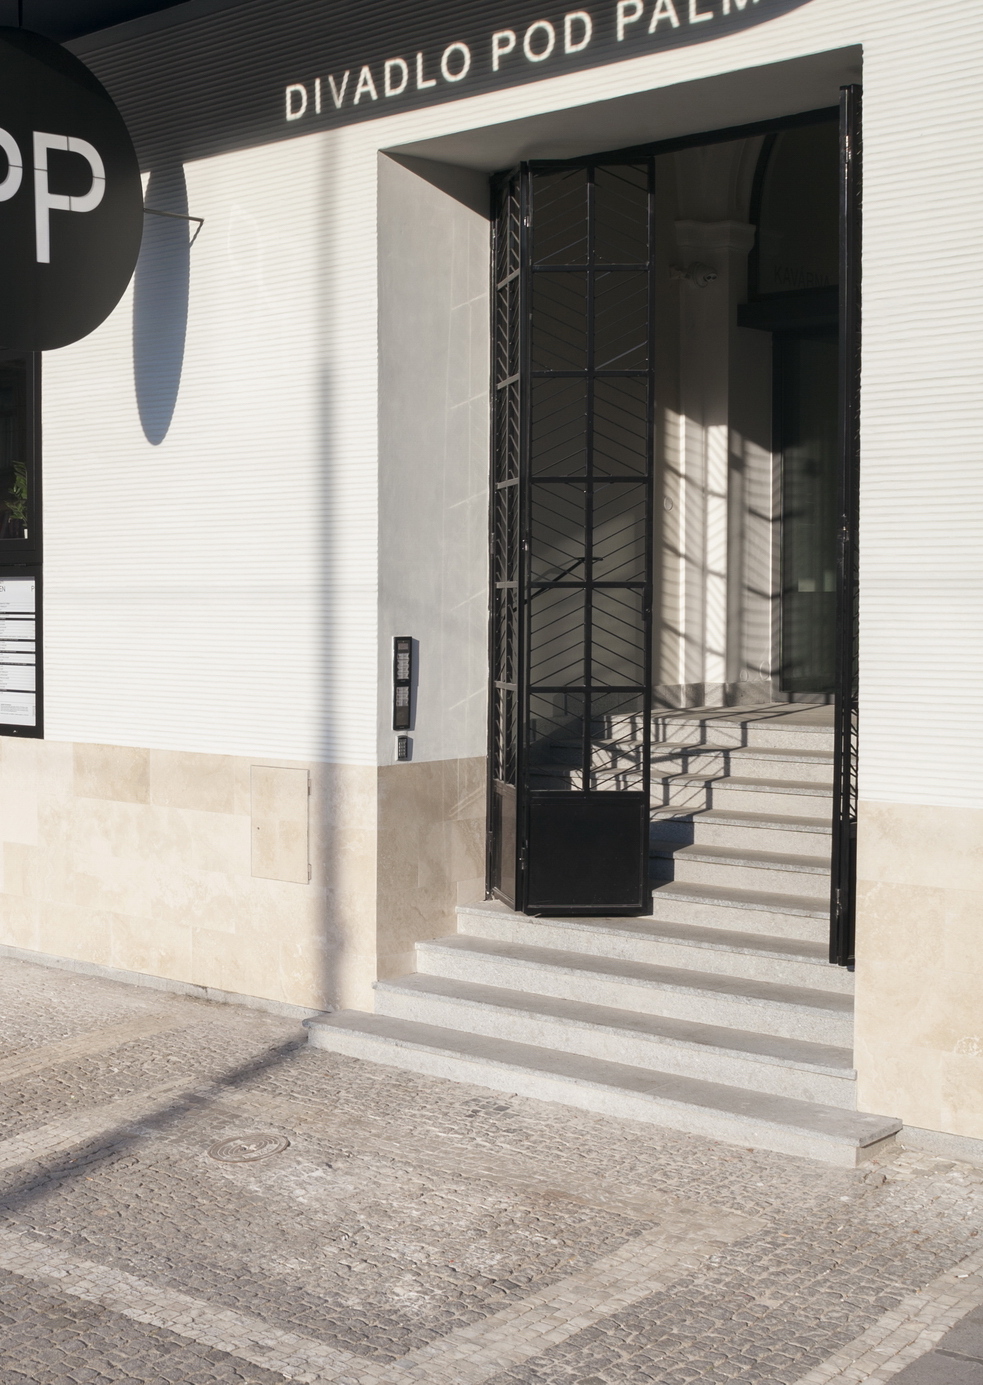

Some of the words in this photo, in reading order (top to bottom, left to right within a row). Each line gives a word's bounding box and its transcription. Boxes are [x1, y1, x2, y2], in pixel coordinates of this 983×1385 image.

[285, 40, 471, 123] DIVADLO
[491, 10, 594, 72] POD
[773, 264, 830, 289] KAVÁRNA
